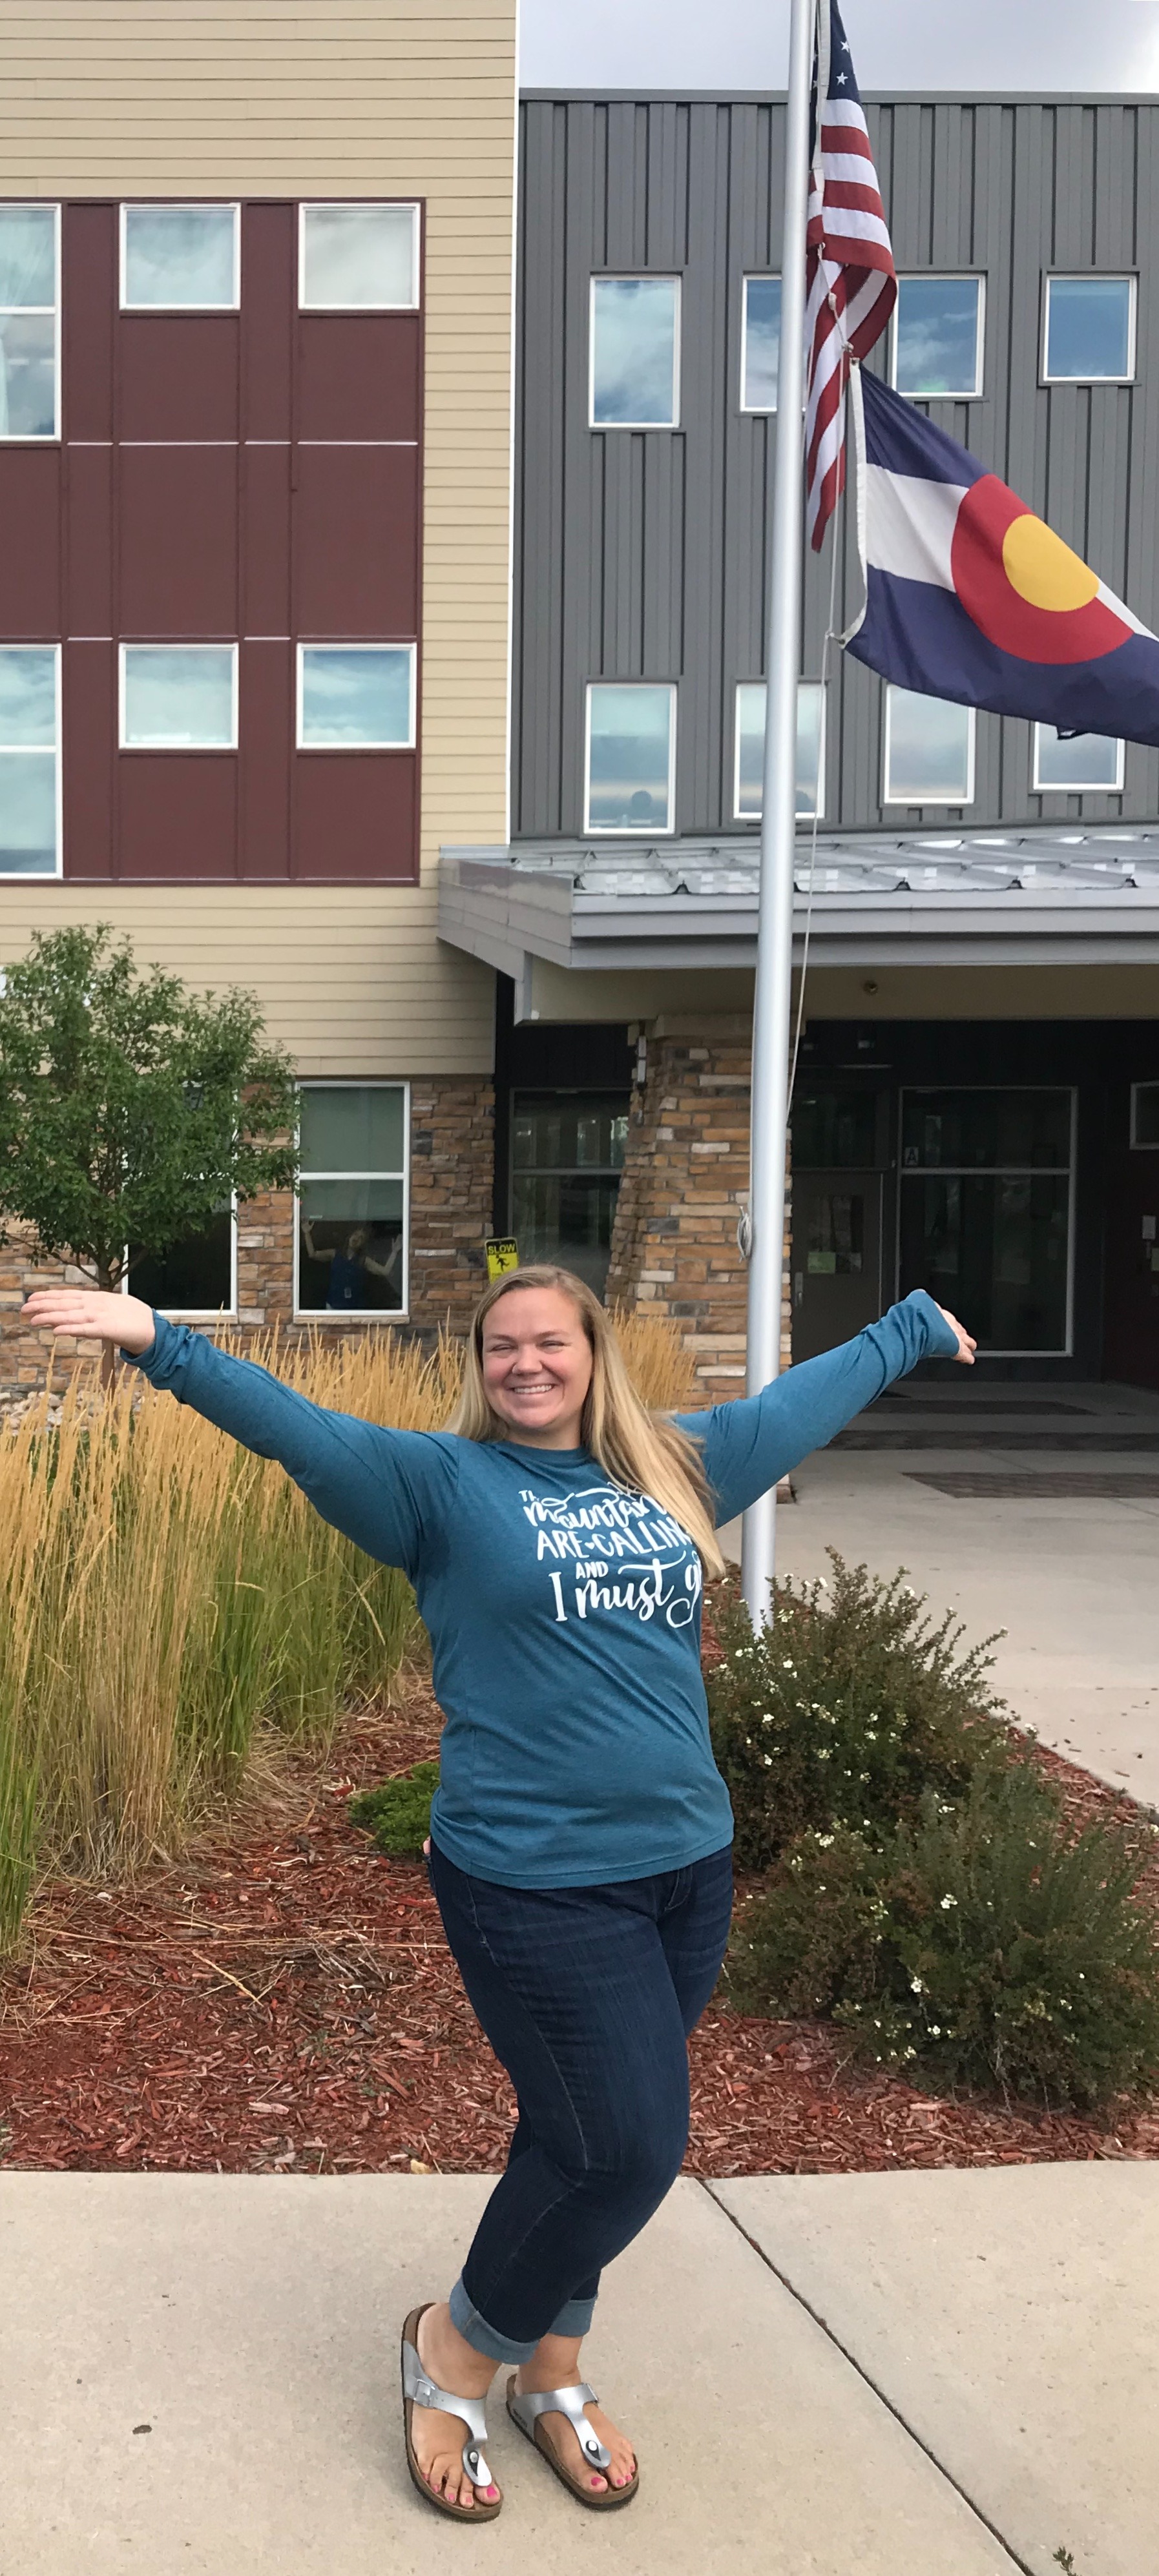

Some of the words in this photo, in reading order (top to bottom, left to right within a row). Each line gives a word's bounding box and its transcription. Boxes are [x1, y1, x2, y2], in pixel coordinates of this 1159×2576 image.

[488, 1244, 515, 1255] SLOW
[523, 1487, 667, 1530] mountain
[537, 1529, 590, 1561] ARE
[591, 1517, 693, 1557] CALLIN
[548, 1571, 568, 1622] I
[574, 1550, 687, 1622] must
[575, 1561, 609, 1580] AND
